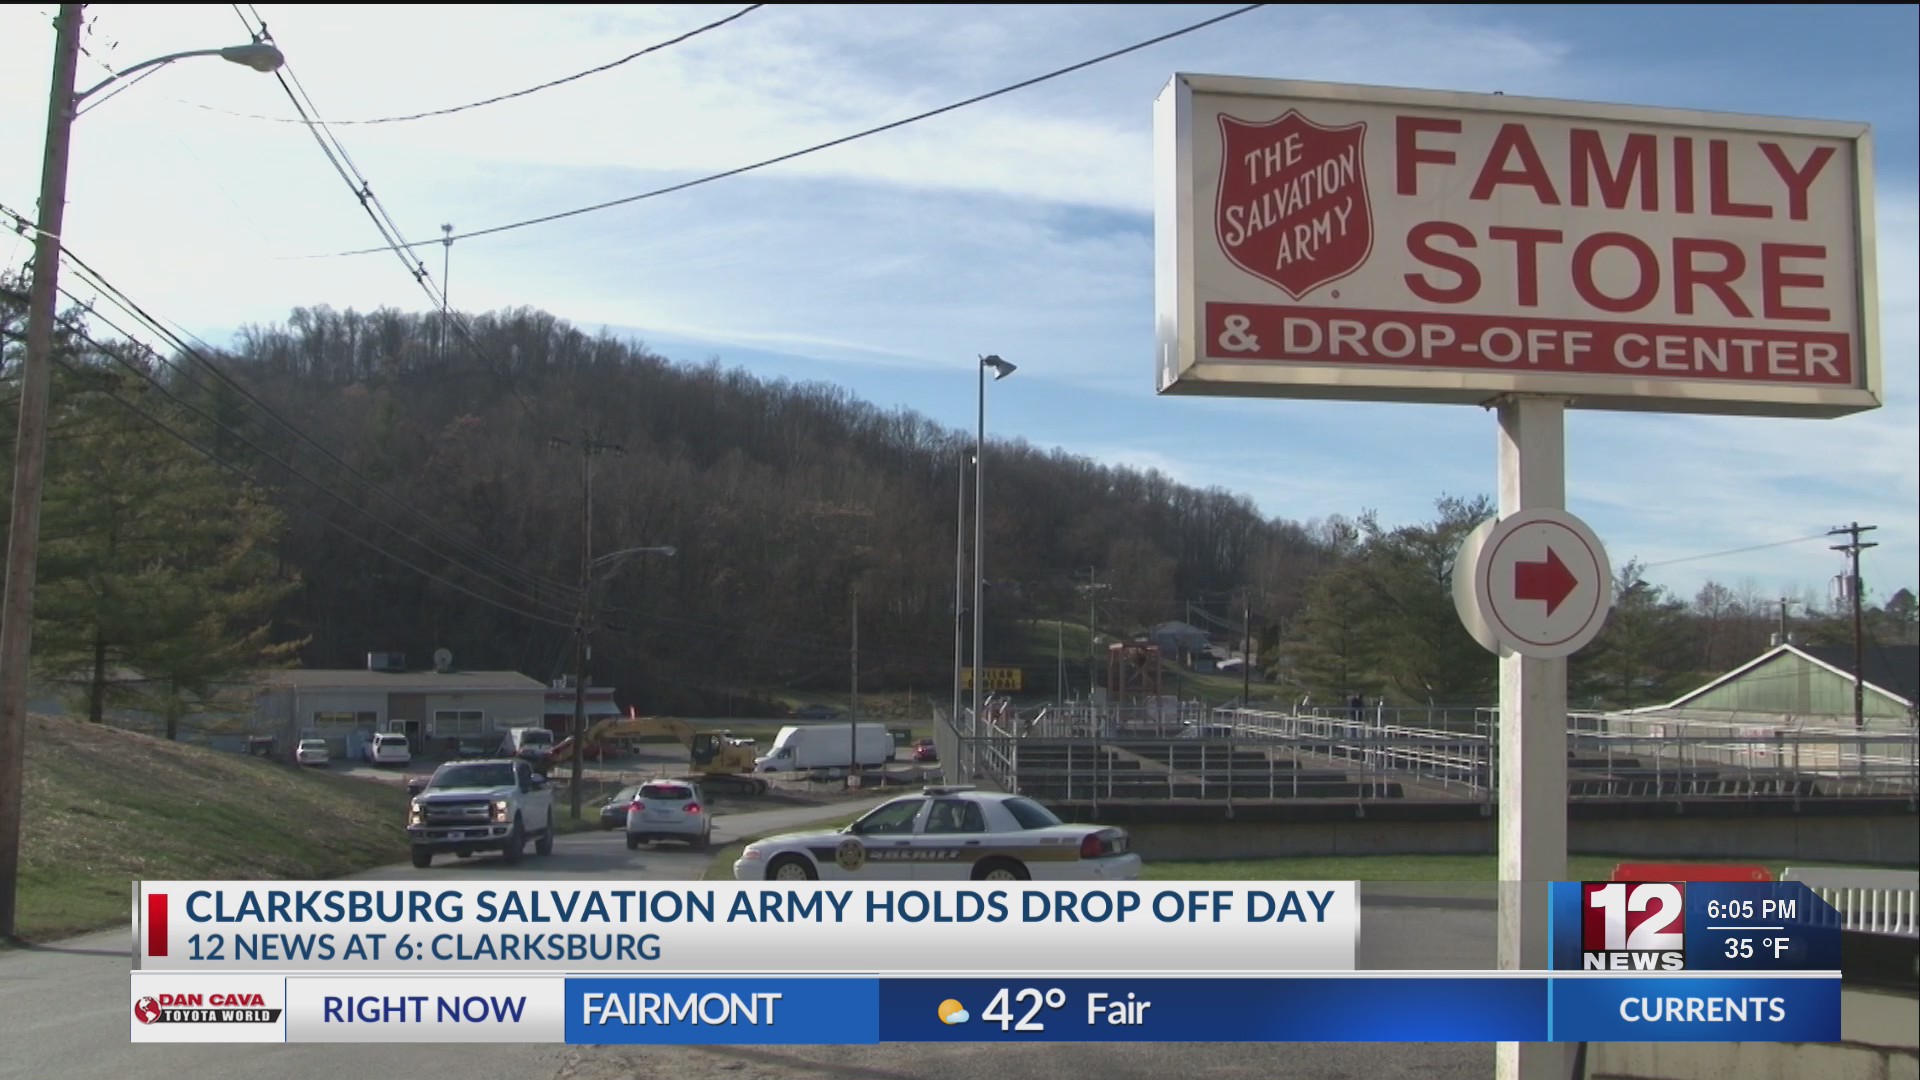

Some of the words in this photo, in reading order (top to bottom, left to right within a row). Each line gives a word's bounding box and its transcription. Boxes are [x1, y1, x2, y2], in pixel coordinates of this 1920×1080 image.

[1225, 144, 1355, 246] SALVATION
[1245, 132, 1304, 186] THE
[1395, 115, 1837, 222] FAMILY
[1276, 196, 1353, 270] ARMY
[1403, 220, 1831, 322] STORE
[1218, 314, 1261, 352] &
[1283, 316, 1593, 365] DROP-OFF
[1613, 333, 1842, 377] CENTER
